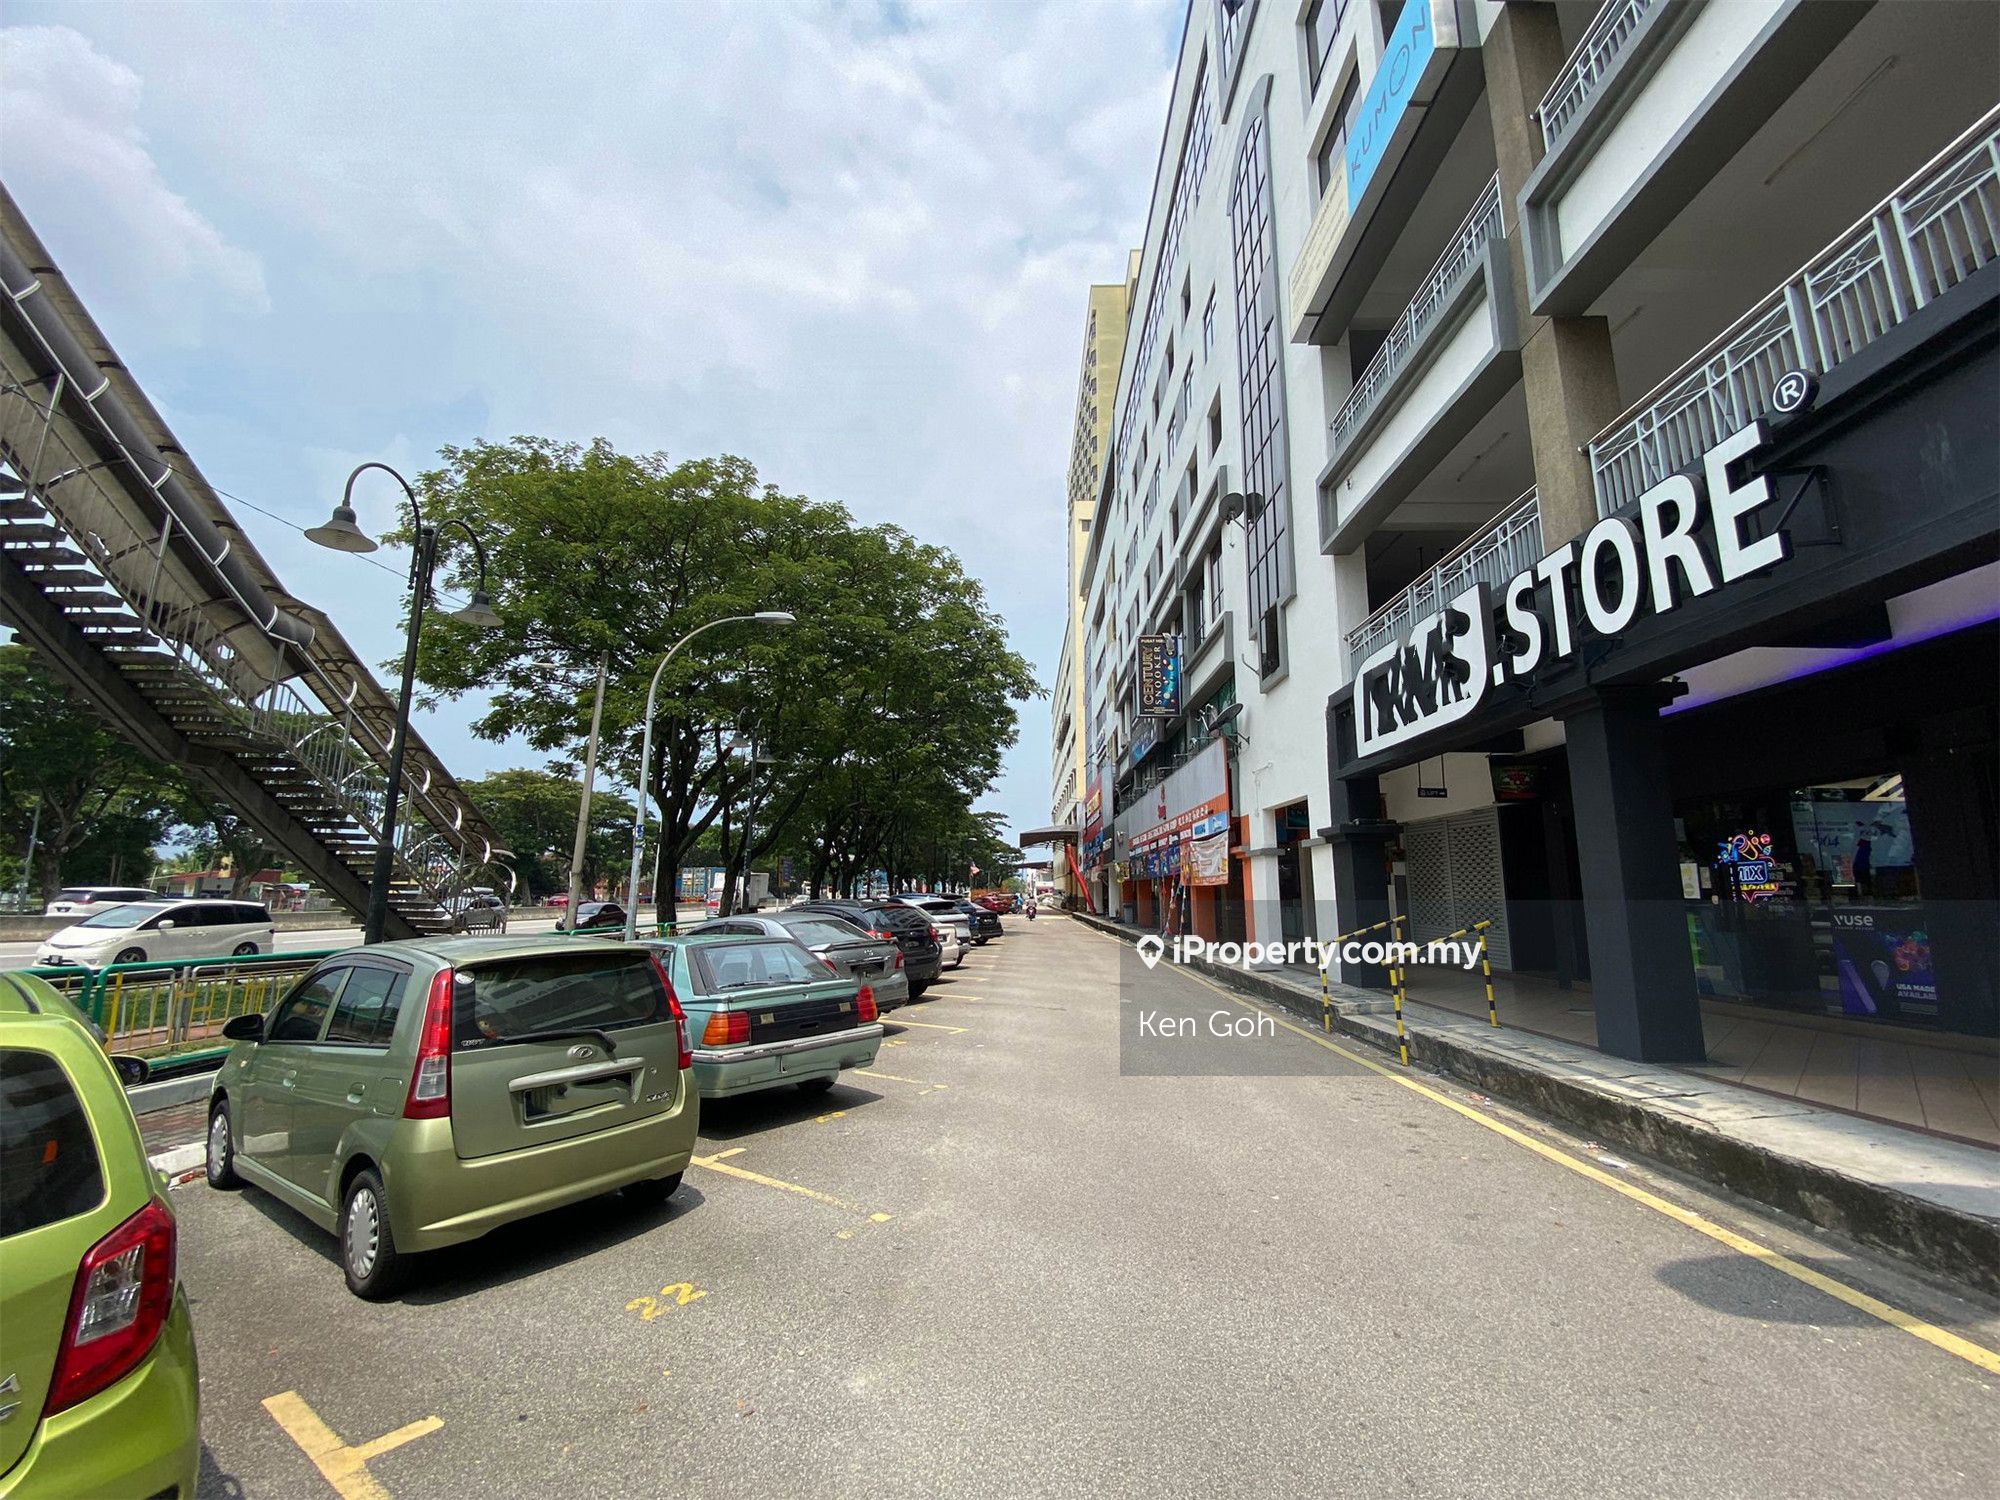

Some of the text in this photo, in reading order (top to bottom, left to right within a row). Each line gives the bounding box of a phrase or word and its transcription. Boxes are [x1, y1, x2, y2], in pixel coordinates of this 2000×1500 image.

[1351, 6, 1426, 182] KUMON
[1142, 646, 1154, 705] CENTURY
[1153, 646, 1163, 705] SNOOKER
[1896, 983, 1912, 991] USA
